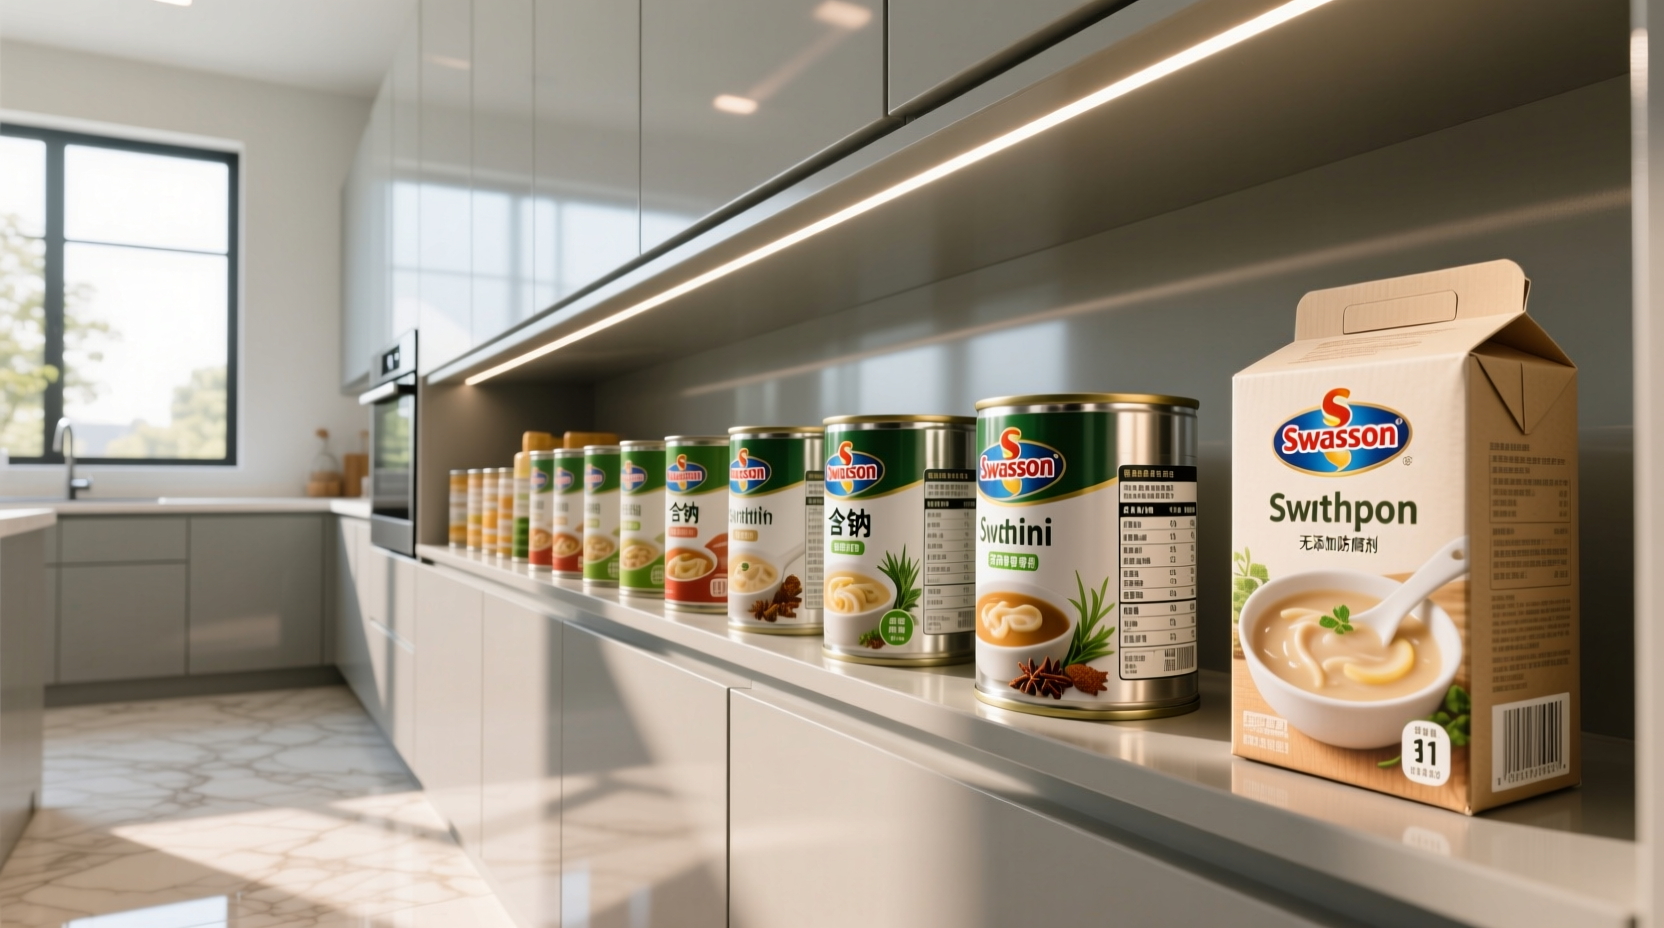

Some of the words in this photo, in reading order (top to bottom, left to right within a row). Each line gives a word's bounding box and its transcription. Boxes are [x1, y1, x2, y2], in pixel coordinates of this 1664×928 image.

[1282, 425, 1397, 453] Swasson
[980, 456, 1054, 480] Swasson
[1269, 491, 1417, 532] Swithpon
[1413, 738, 1437, 767] 31
